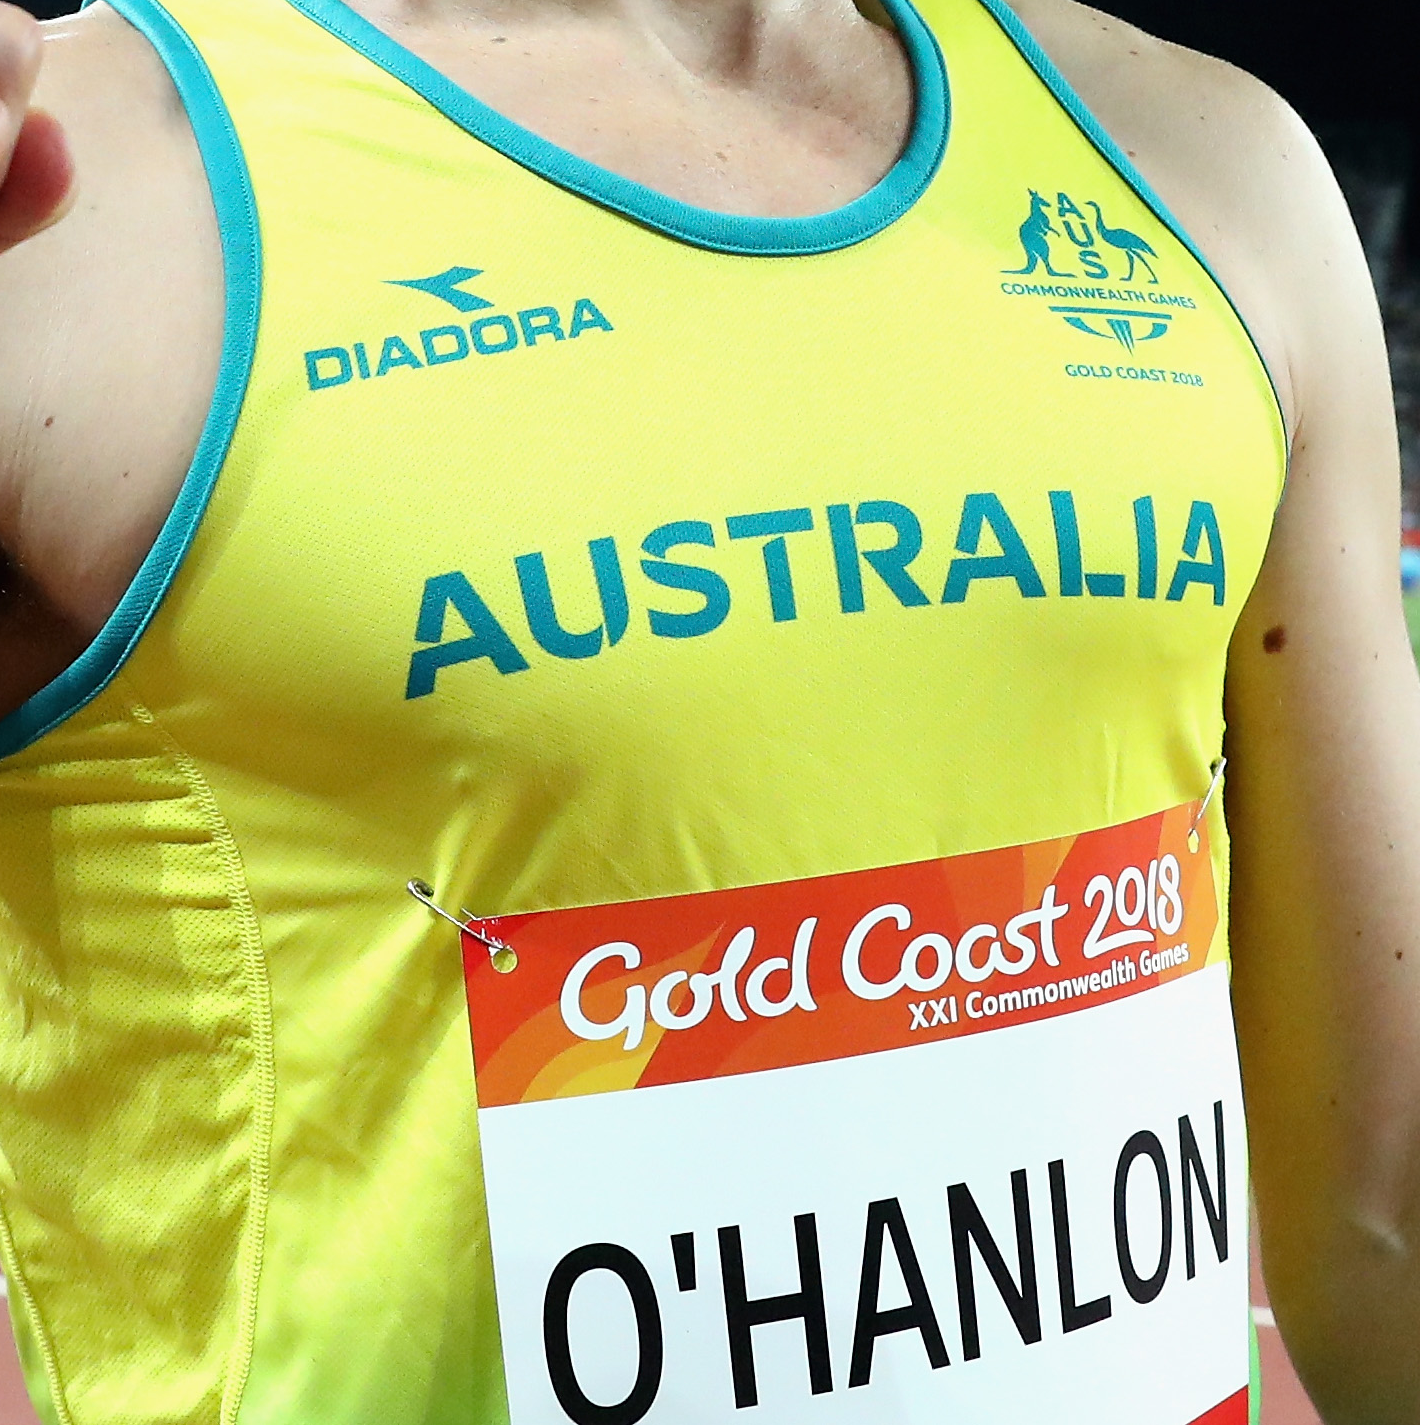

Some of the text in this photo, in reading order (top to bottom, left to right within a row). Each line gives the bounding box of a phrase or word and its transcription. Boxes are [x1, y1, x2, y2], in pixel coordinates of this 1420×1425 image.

[1056, 191, 1110, 280] AUS
[1000, 282, 1197, 310] COMMONWEALTH GAMES
[303, 298, 614, 391] DIADORA
[1064, 363, 1204, 387] GOLD COAST 2018
[405, 489, 1226, 699] AUSTRALIA
[558, 853, 1184, 1051] Gold Coast 2018
[907, 941, 1191, 1031] XXI Commonwealth Games
[543, 1100, 1229, 1425] O'HANLON
